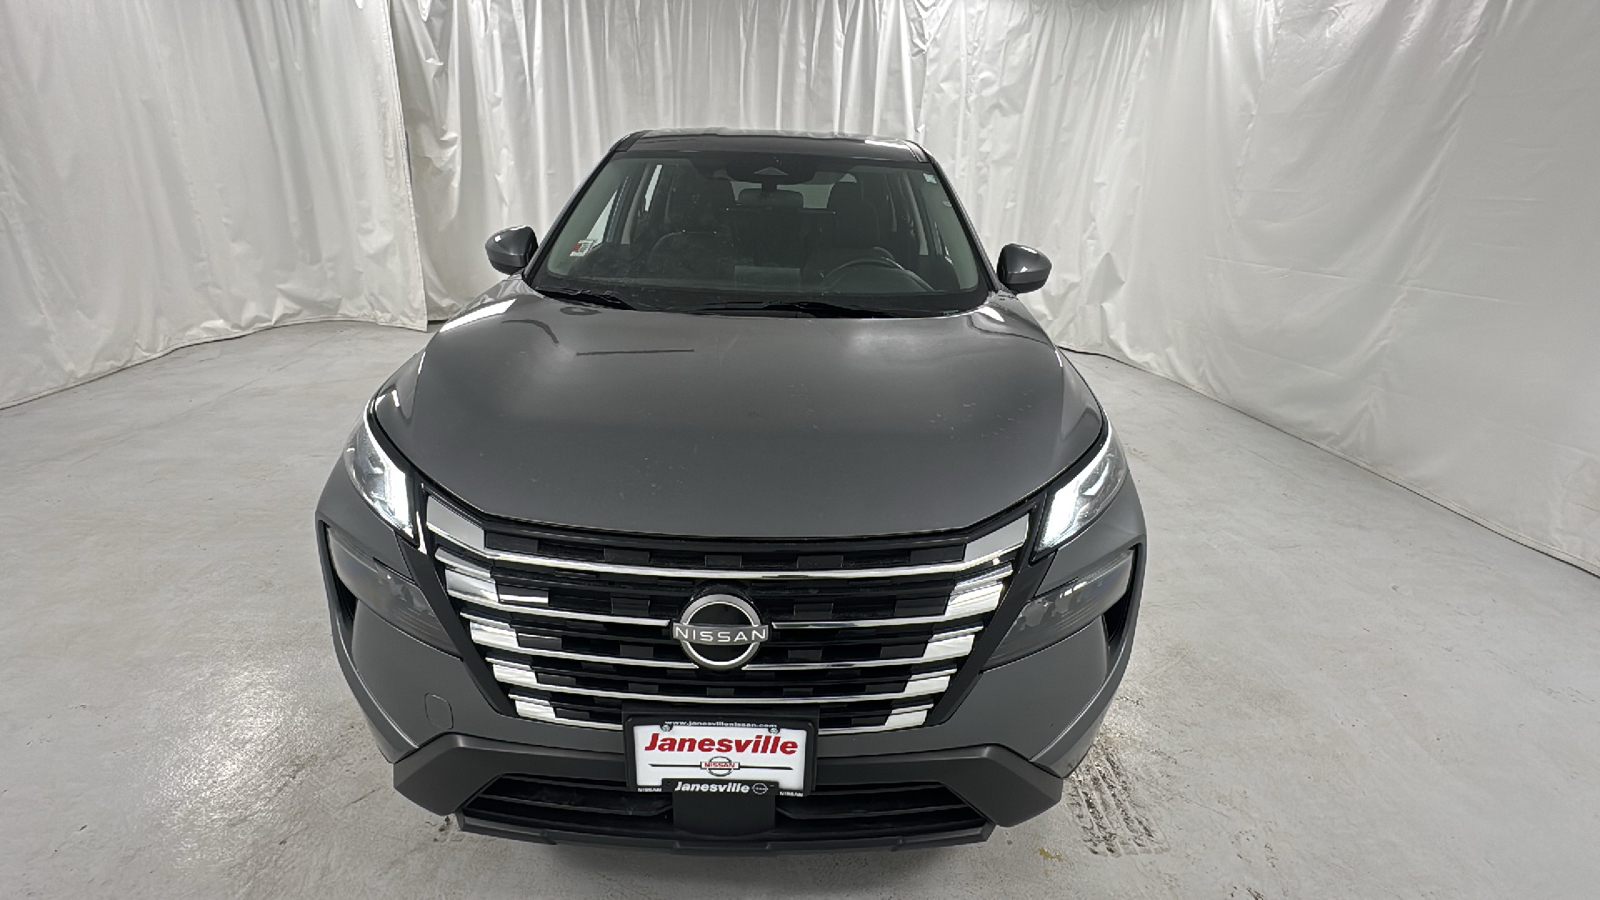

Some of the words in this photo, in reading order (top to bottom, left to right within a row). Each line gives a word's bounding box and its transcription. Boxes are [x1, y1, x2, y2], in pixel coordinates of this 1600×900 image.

[675, 626, 765, 642] NISSAN
[644, 733, 798, 755] Janesville
[674, 781, 750, 794] Janesville
